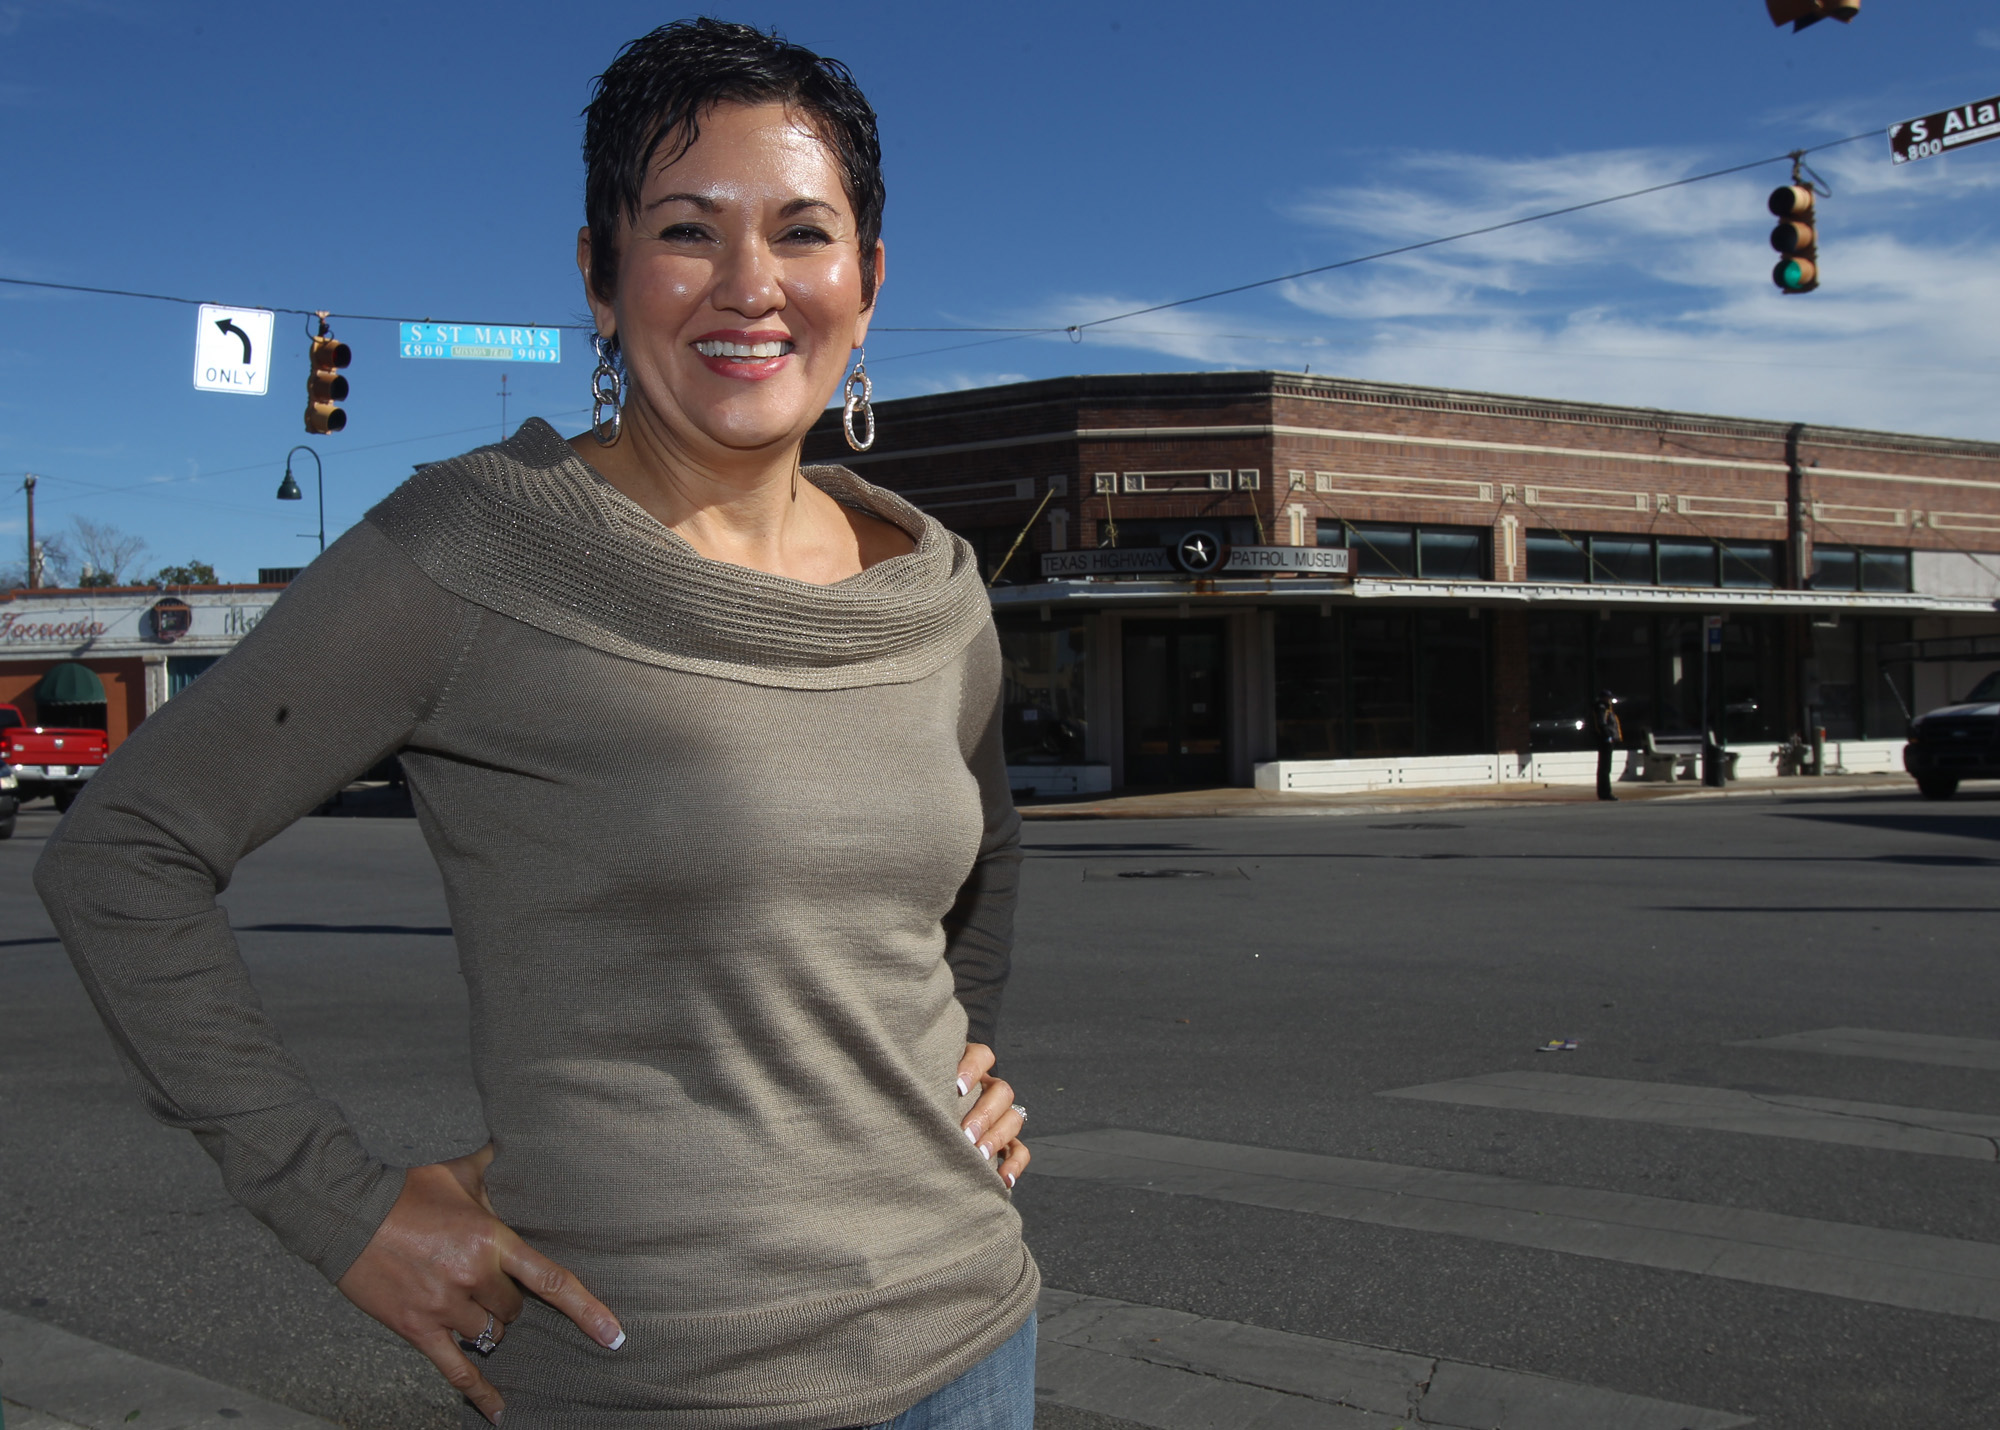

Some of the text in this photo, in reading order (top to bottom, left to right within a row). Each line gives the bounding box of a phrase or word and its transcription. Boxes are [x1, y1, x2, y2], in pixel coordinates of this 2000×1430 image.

[1910, 119, 1928, 142] S
[1943, 101, 2000, 135] Ala
[1907, 138, 1942, 161] 800
[411, 325, 550, 346] S ST MARYS
[413, 344, 443, 357] 800
[518, 348, 546, 361] 900
[206, 367, 256, 385] ONLY
[1044, 551, 1347, 572] TEXAS HIGHWAY PATROL MUSEUM
[0, 612, 109, 638] Focaccia
